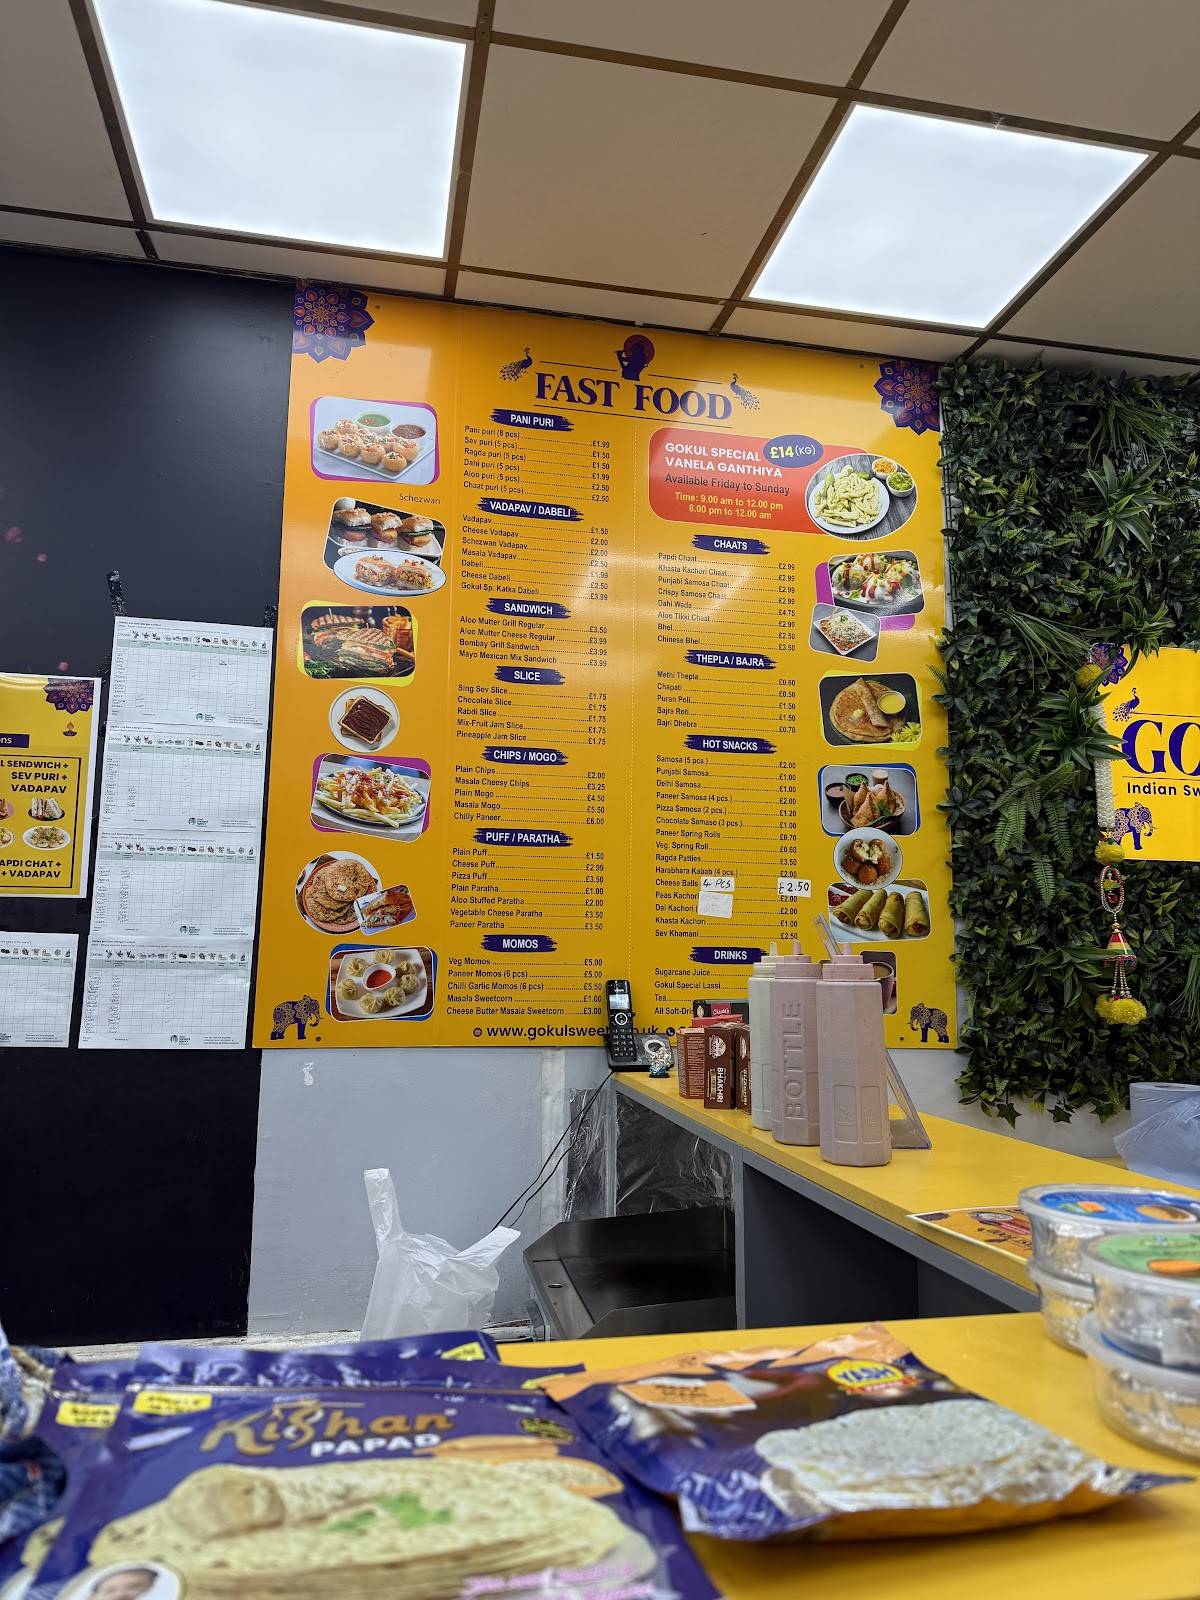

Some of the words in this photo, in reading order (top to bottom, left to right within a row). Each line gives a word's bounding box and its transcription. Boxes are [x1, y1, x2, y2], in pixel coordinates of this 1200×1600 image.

[536, 372, 620, 407] FAST
[634, 385, 732, 420] FOOD
[510, 414, 531, 425] PANI
[533, 416, 554, 427] PURI
[665, 443, 708, 456] GOKUL
[711, 447, 760, 461] SPECIAL
[770, 447, 794, 458] £14
[795, 445, 816, 457] (KG)
[482, 461, 495, 469] puri
[505, 464, 520, 472] pcs)
[665, 457, 714, 471] VANELA
[718, 462, 782, 478] GANTHIYA
[665, 473, 708, 487] Available
[712, 478, 740, 491] Friday
[744, 482, 752, 490] to
[755, 483, 790, 496] Sunday
[400, 493, 440, 504] Schezwan
[675, 491, 699, 501] Time:
[701, 493, 718, 504] 9.00
[736, 497, 743, 506] to
[747, 499, 768, 509] 12.00
[770, 502, 783, 511] pm
[490, 501, 531, 513] VADAPAV
[539, 506, 570, 517] DABELI
[689, 504, 706, 513] 8.00
[709, 508, 721, 516] pm
[724, 508, 732, 516] to
[736, 508, 757, 518] 12.00
[760, 512, 771, 520] am
[463, 526, 488, 535] Cheese
[490, 528, 519, 538] Vadapav
[714, 539, 748, 550] CHAATS
[462, 571, 487, 580] Cheese
[489, 573, 510, 582] Dabeli
[504, 602, 553, 615] SANDWICH
[460, 616, 476, 624] Aloo
[478, 618, 500, 626] Mutter
[502, 619, 517, 627] Grill
[519, 621, 544, 630] Regular
[459, 650, 478, 659] Mayo
[480, 651, 508, 660] Mexican
[510, 653, 522, 661] Mix
[524, 655, 556, 664] Sandwich
[696, 654, 729, 665] THEPLA
[736, 656, 764, 667] BAJRA
[514, 671, 540, 681] SLICE
[458, 684, 474, 693] Sing
[657, 719, 672, 728] Bajri
[674, 720, 697, 728] Dhebra
[703, 739, 721, 749] HOT
[723, 741, 757, 750] SNACKS
[493, 750, 521, 760] CHIPS
[529, 752, 557, 762] MOGO
[7, 760, 61, 769] SENDWICH
[12, 772, 32, 780] SEV
[455, 765, 473, 774] Plain
[475, 766, 495, 776] Chips
[455, 777, 479, 785] Masala
[482, 779, 507, 788] Cheesy
[510, 780, 529, 788] Chips
[12, 784, 66, 793] VADAPAV
[1127, 782, 1177, 796] Indian
[656, 792, 679, 800] Paneer
[681, 793, 707, 801] Samosa
[486, 832, 510, 842] PUFF
[518, 833, 560, 844] PARATHA
[656, 829, 679, 837] Paneer
[681, 830, 702, 839] Spring
[453, 848, 470, 856] Plain
[473, 849, 487, 857] Puff
[586, 852, 604, 860] £1.50
[25, 860, 53, 868] CHAT
[452, 860, 478, 868] Cheese
[10, 870, 60, 878] VADAPAV
[703, 880, 711, 888] 4
[715, 878, 731, 889] PCS
[451, 909, 485, 918] Vegetable
[488, 909, 513, 917] Cheese
[516, 910, 543, 918] Paratha
[655, 904, 667, 912] Dal
[668, 904, 694, 912] Kachori
[670, 930, 698, 938] Khamani
[503, 939, 538, 949] MOMOS
[714, 950, 748, 960] DRINKS
[449, 958, 462, 967] Veg
[464, 958, 491, 966] Momos
[655, 968, 690, 978] Sugarcane
[693, 969, 710, 977] Juice
[448, 982, 466, 990] Chilli
[469, 982, 490, 990] Garlic
[520, 982, 527, 991] (6
[528, 983, 544, 991] pcs)
[655, 980, 674, 989] Gokul
[676, 981, 701, 992] Special
[703, 982, 721, 990] Lassi
[447, 1007, 473, 1015] Cheese
[476, 1007, 498, 1015] Butter
[500, 1007, 525, 1015] Masala
[527, 1007, 564, 1015] Sweetcorn
[655, 1007, 664, 1015] All
[666, 1007, 693, 1016] Soft-Dri
[487, 1024, 659, 1040] www.gokulsweeto.uk
[782, 1003, 806, 1120] BOTTLE
[838, 1365, 896, 1384] YASH
[310, 1432, 442, 1458] PAPAD
